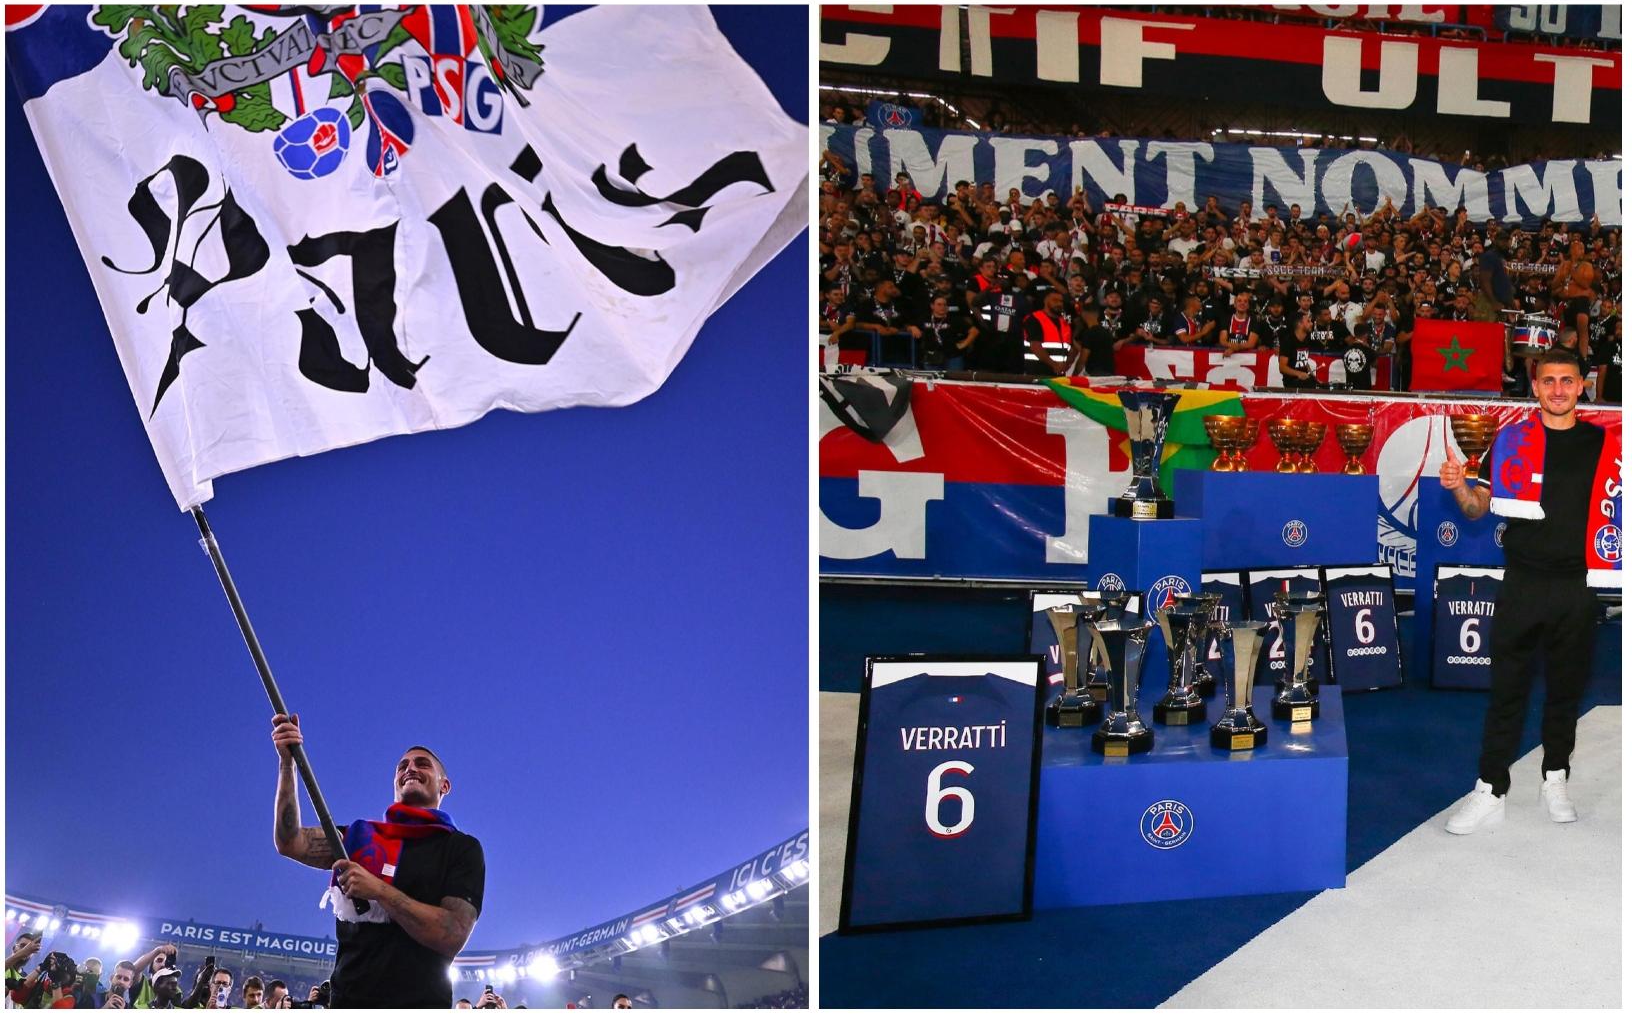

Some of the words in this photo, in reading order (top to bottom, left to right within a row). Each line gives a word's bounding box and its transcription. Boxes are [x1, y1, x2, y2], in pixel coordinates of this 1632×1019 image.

[1322, 35, 1615, 124] ULT
[404, 54, 503, 132] PSG
[1104, 203, 1168, 217] PARIS
[101, 142, 775, 422] Paris
[1101, 575, 1124, 590] PARIS
[1155, 577, 1185, 591] PARIS
[1341, 591, 1383, 607] VERRATTI
[1448, 600, 1495, 616] VERRATTI
[1354, 608, 1375, 644] 6
[1459, 618, 1481, 653] 6
[1347, 646, 1387, 656] ooredoo
[1447, 656, 1491, 665] ooredoo
[925, 760, 975, 839] 6
[1149, 802, 1185, 815] PARIS
[729, 859, 758, 892] ICI
[161, 923, 215, 941] PARIS
[219, 930, 252, 946] EST
[256, 936, 336, 955] MAGIQUE
